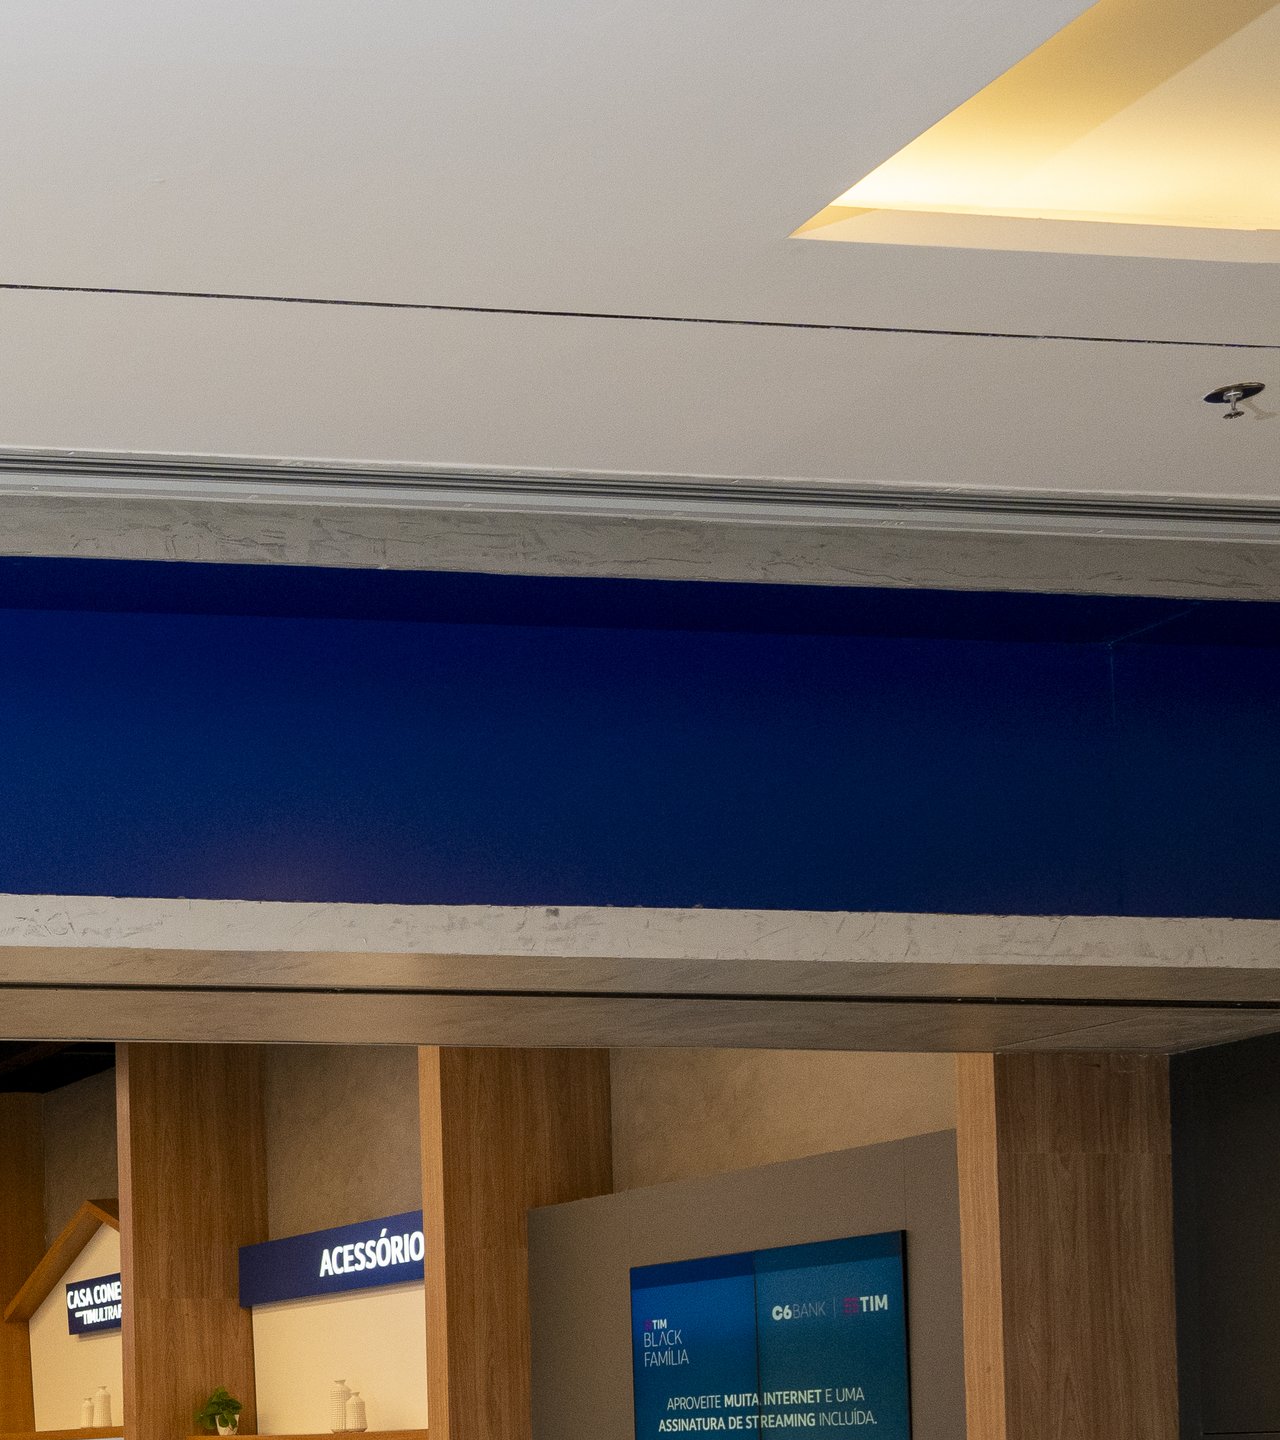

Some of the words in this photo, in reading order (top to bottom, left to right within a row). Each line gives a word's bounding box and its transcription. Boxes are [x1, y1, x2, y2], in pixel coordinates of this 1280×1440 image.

[67, 1287, 94, 1310] CASA
[860, 1294, 888, 1313] TIM
[652, 1318, 667, 1330] TIM
[643, 1329, 683, 1347] BLACK
[644, 1347, 689, 1367] FAMÍLIA
[667, 1395, 721, 1410] APROVEITE
[724, 1394, 758, 1407] MUITA
[764, 1390, 822, 1404] INTERNET
[826, 1388, 832, 1402] E
[836, 1388, 864, 1402] UMA
[659, 1418, 725, 1431] ASSINATURA
[728, 1416, 743, 1429] DE
[746, 1413, 815, 1428] STREAMING
[820, 1409, 877, 1425] INCLUÍDA.
